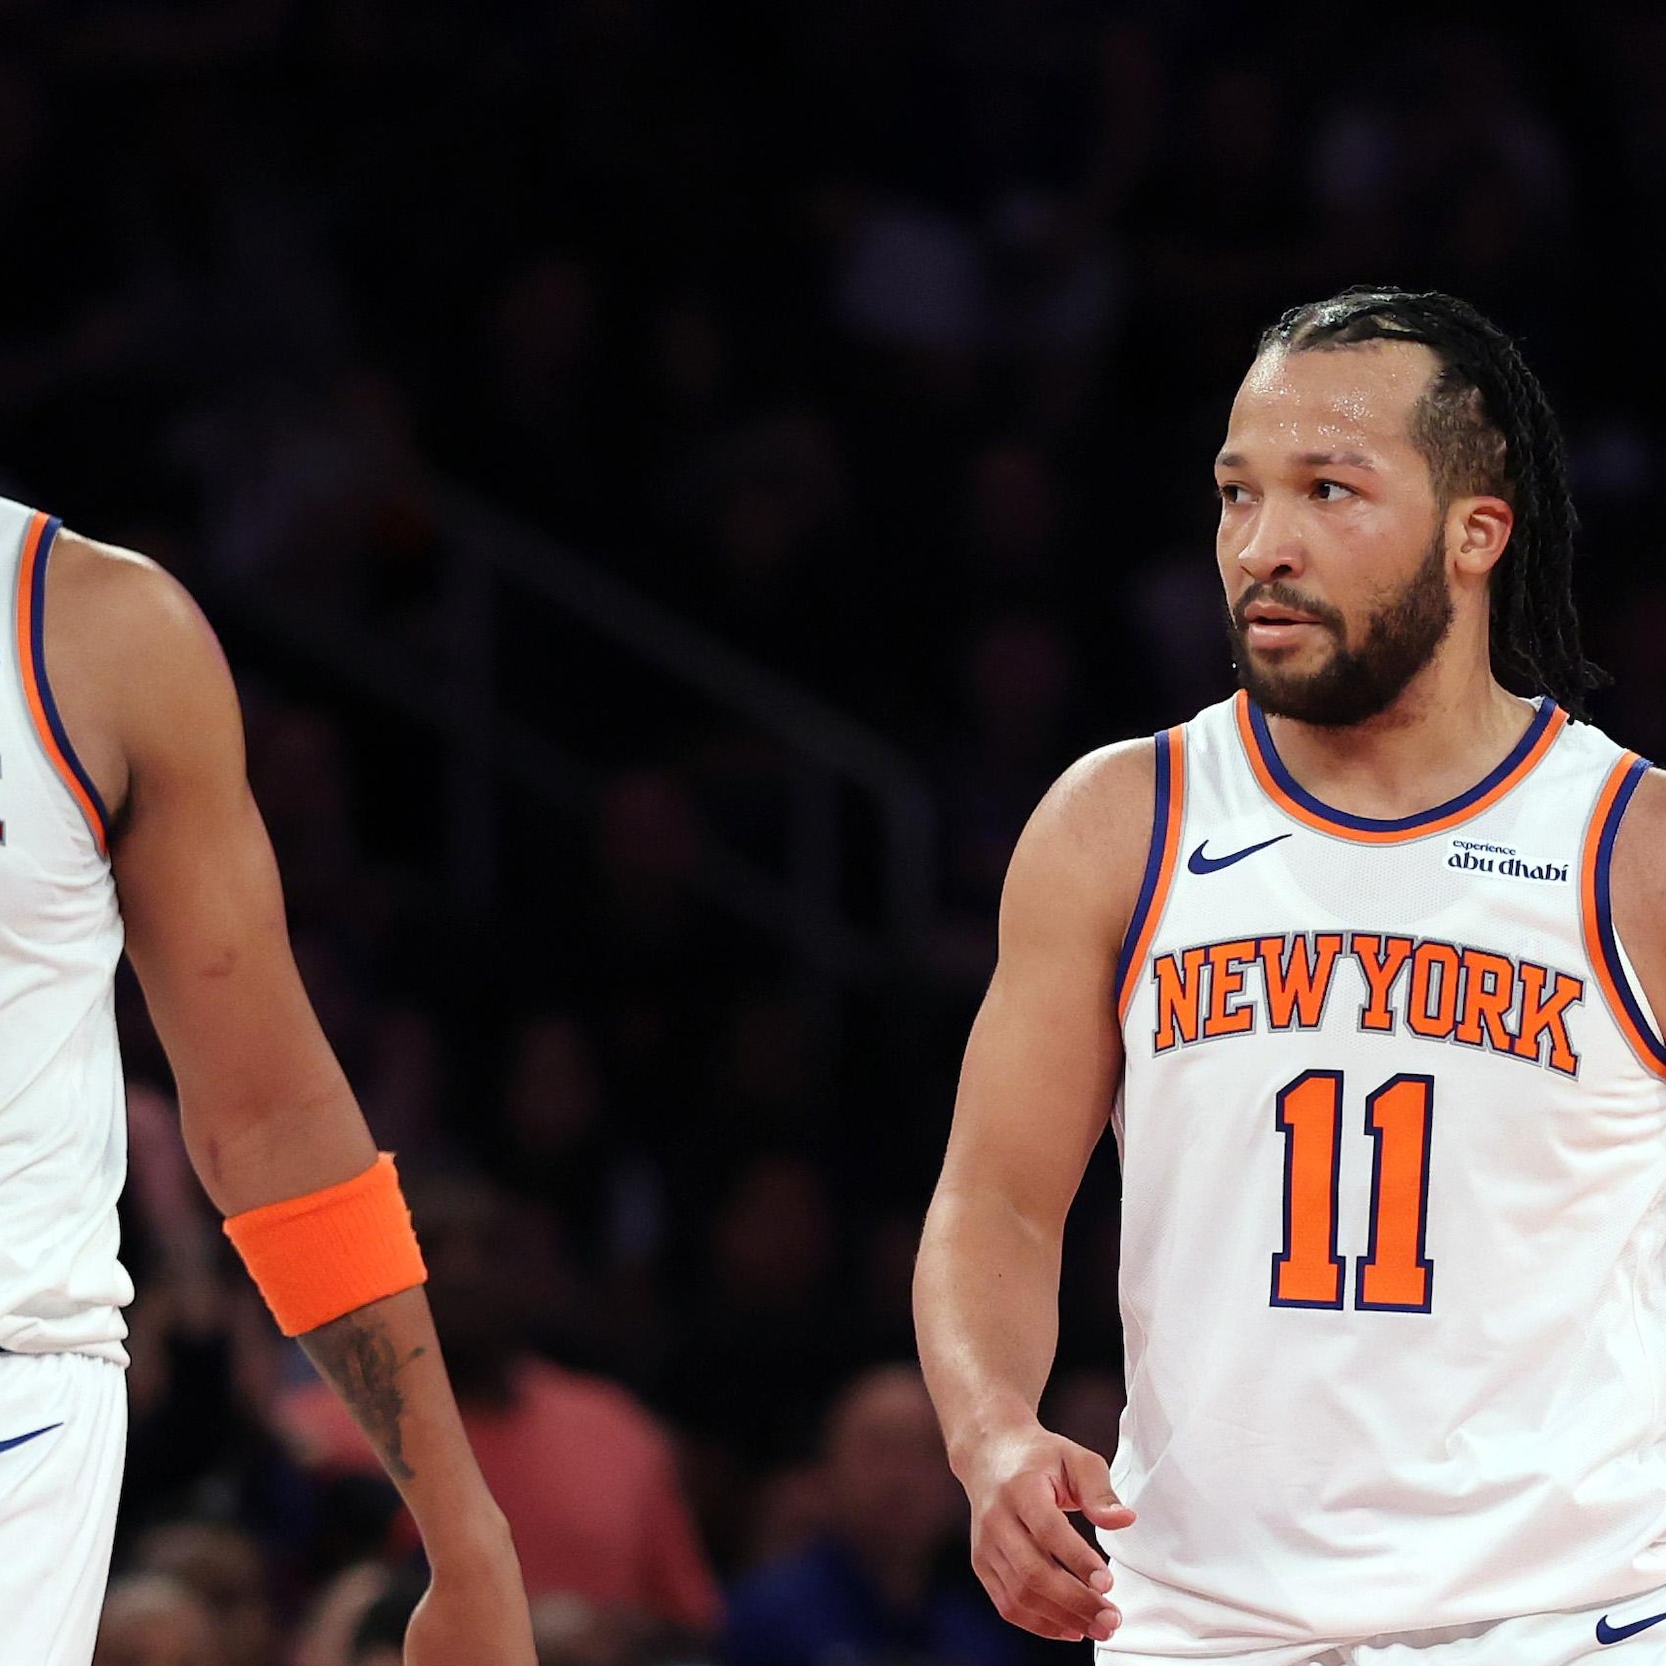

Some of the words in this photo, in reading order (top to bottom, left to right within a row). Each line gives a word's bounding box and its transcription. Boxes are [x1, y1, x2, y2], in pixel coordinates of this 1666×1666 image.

[1447, 851, 1493, 872] abu
[1498, 858, 1569, 881] dhabi
[1452, 840, 1516, 855] experience
[1151, 929, 1345, 1059] NEW
[1347, 929, 1588, 1083] YORK
[1269, 1069, 1435, 1314] 11
